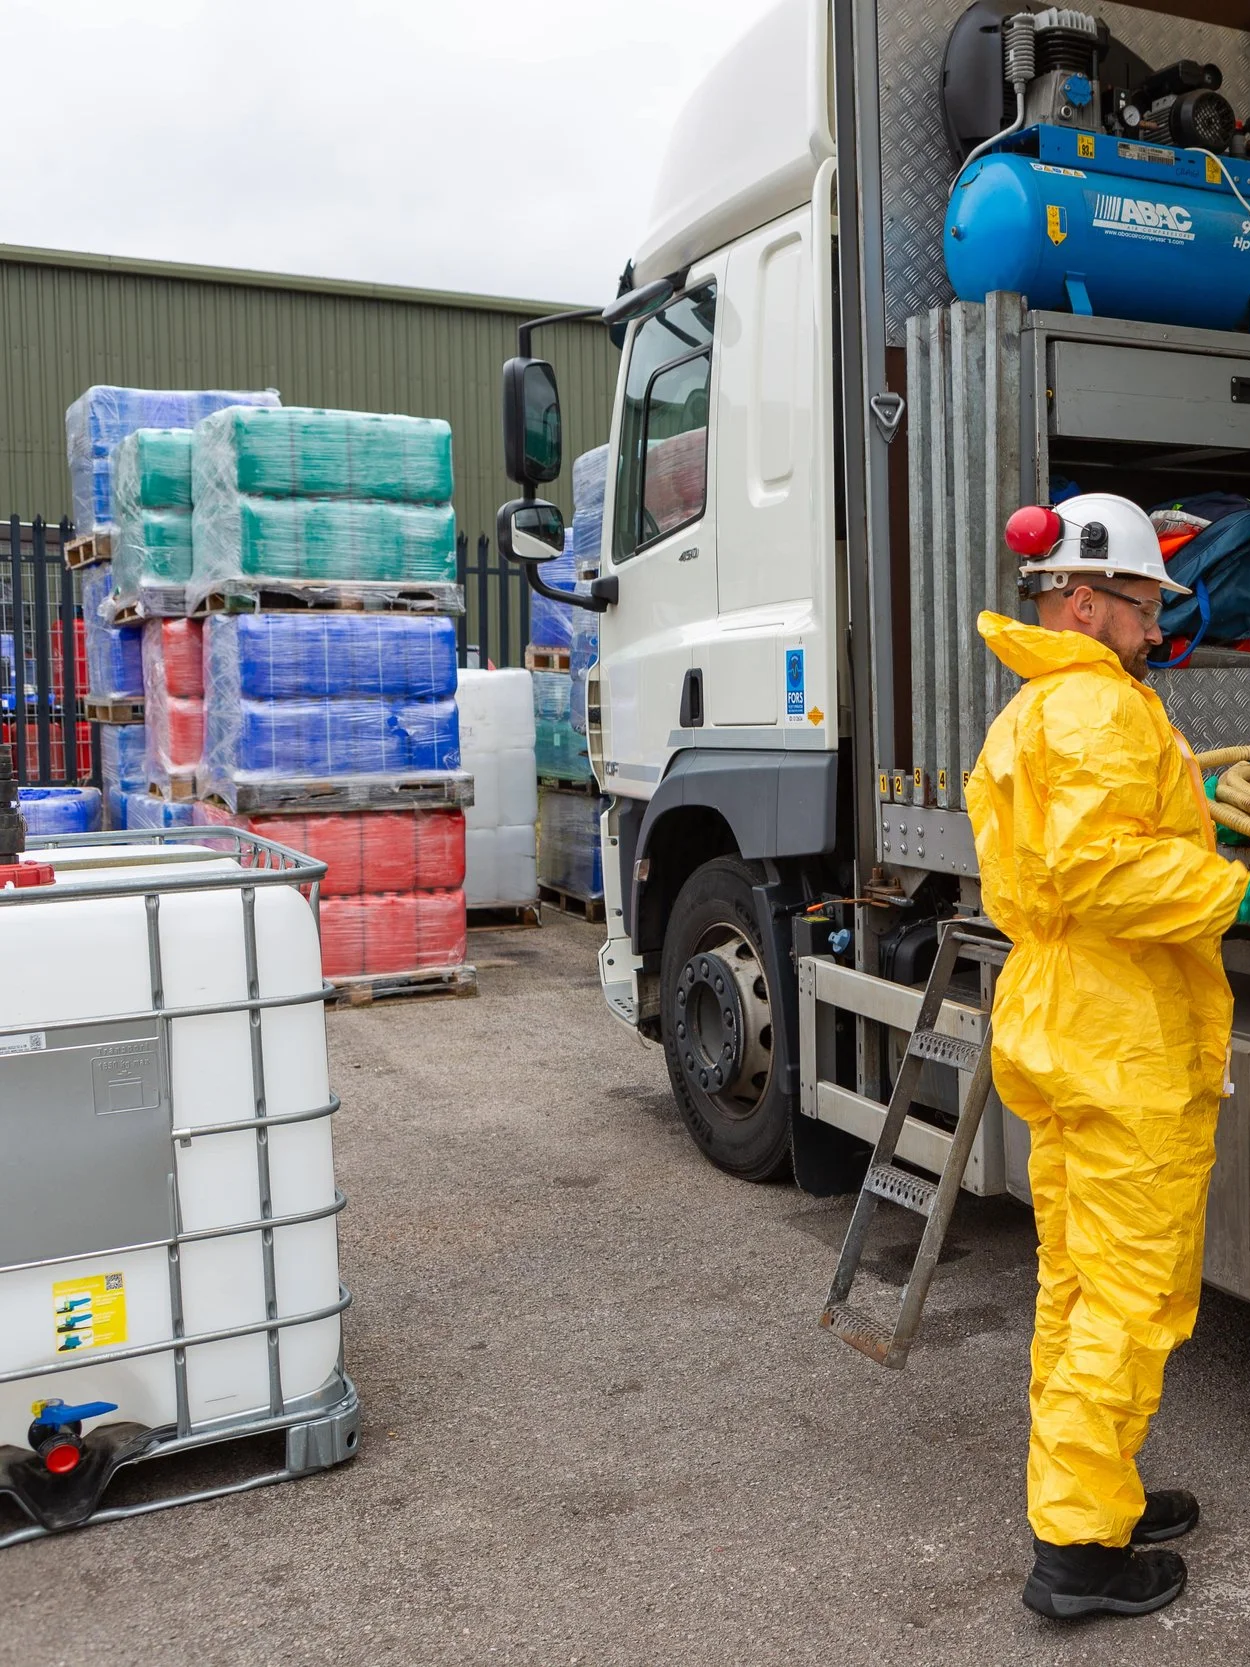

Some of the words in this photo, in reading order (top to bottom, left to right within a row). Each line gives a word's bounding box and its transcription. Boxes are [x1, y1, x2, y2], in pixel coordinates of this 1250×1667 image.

[1120, 198, 1193, 232] ABAC
[1233, 236, 1250, 252] Hp
[787, 691, 804, 704] FORS
[881, 776, 887, 791] 1
[895, 777, 901, 793] 2
[915, 769, 921, 785] 3
[939, 772, 946, 788] 4
[963, 772, 969, 787] 5
